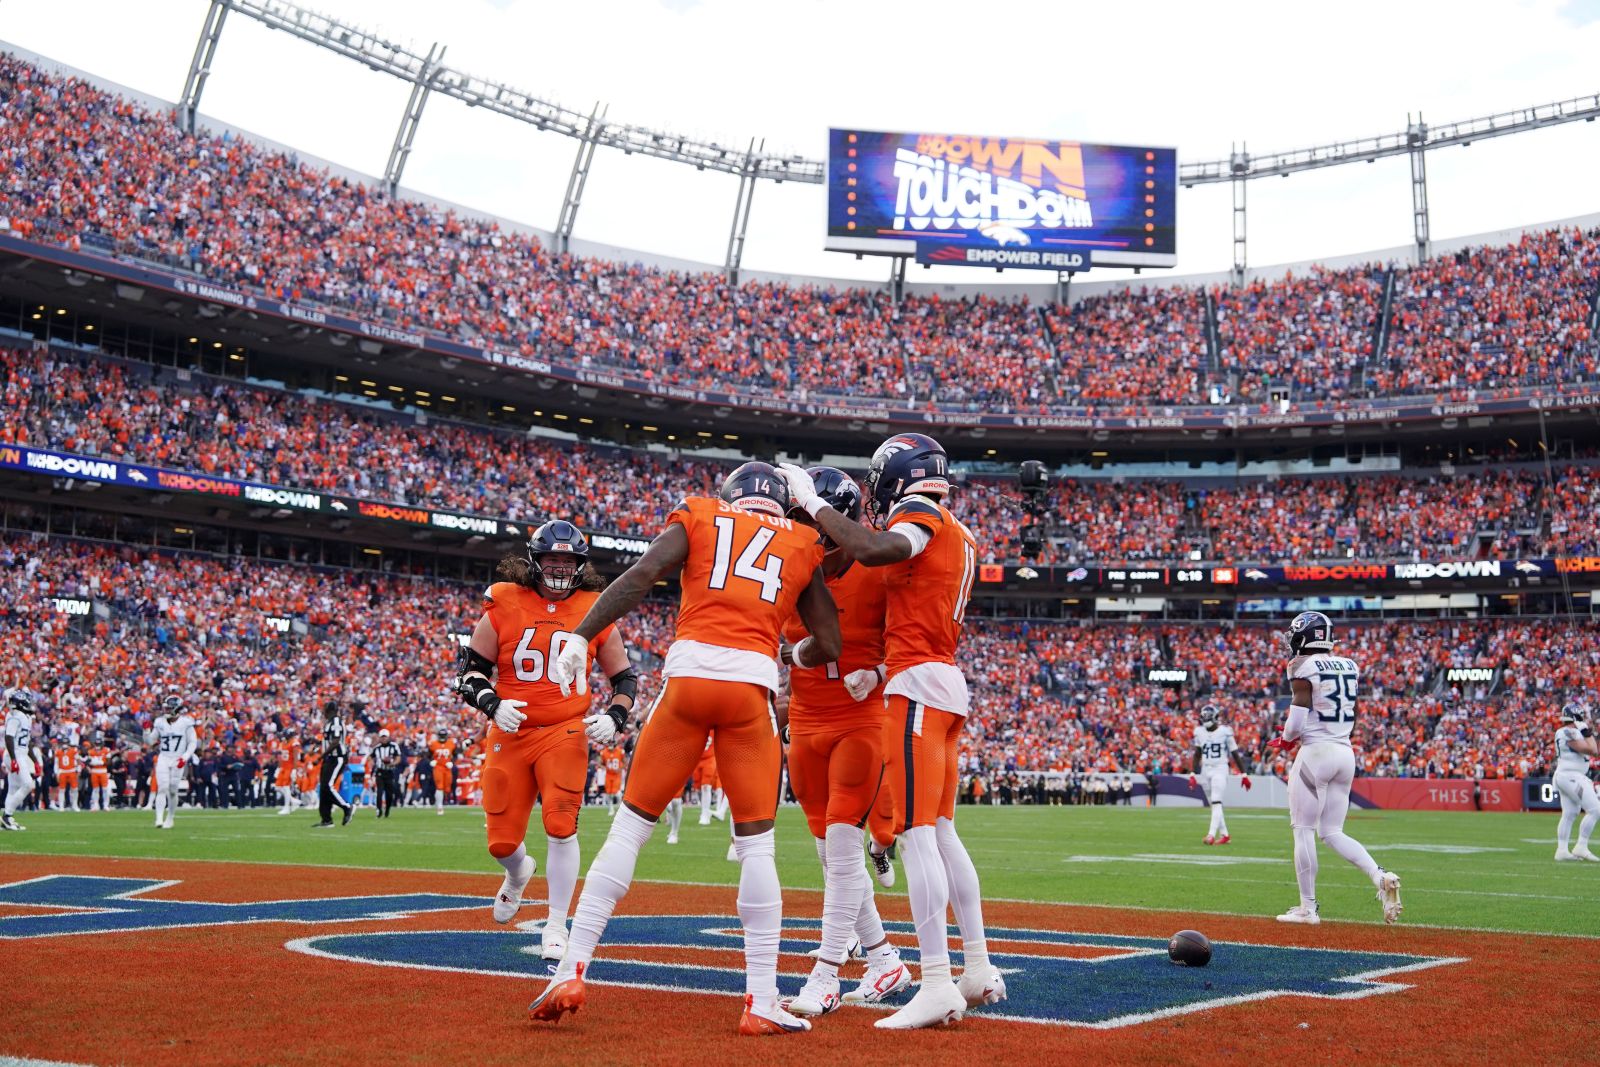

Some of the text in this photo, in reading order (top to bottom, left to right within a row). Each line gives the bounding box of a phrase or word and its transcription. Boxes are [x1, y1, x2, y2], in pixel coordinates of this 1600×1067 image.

[966, 249, 1083, 266] EMPOWER FIELD
[199, 285, 244, 305] MANNING
[291, 307, 326, 324] MILLER
[1369, 409, 1398, 420] SMITH
[936, 459, 945, 475] 11
[754, 478, 770, 494] 14
[739, 499, 778, 510] BRONCOS
[708, 515, 784, 605] 14
[953, 537, 976, 625] 11
[1315, 660, 1345, 671] BAKER
[160, 734, 183, 752] 37
[1202, 743, 1221, 759] 49
[1429, 788, 1501, 804] THIS IS
